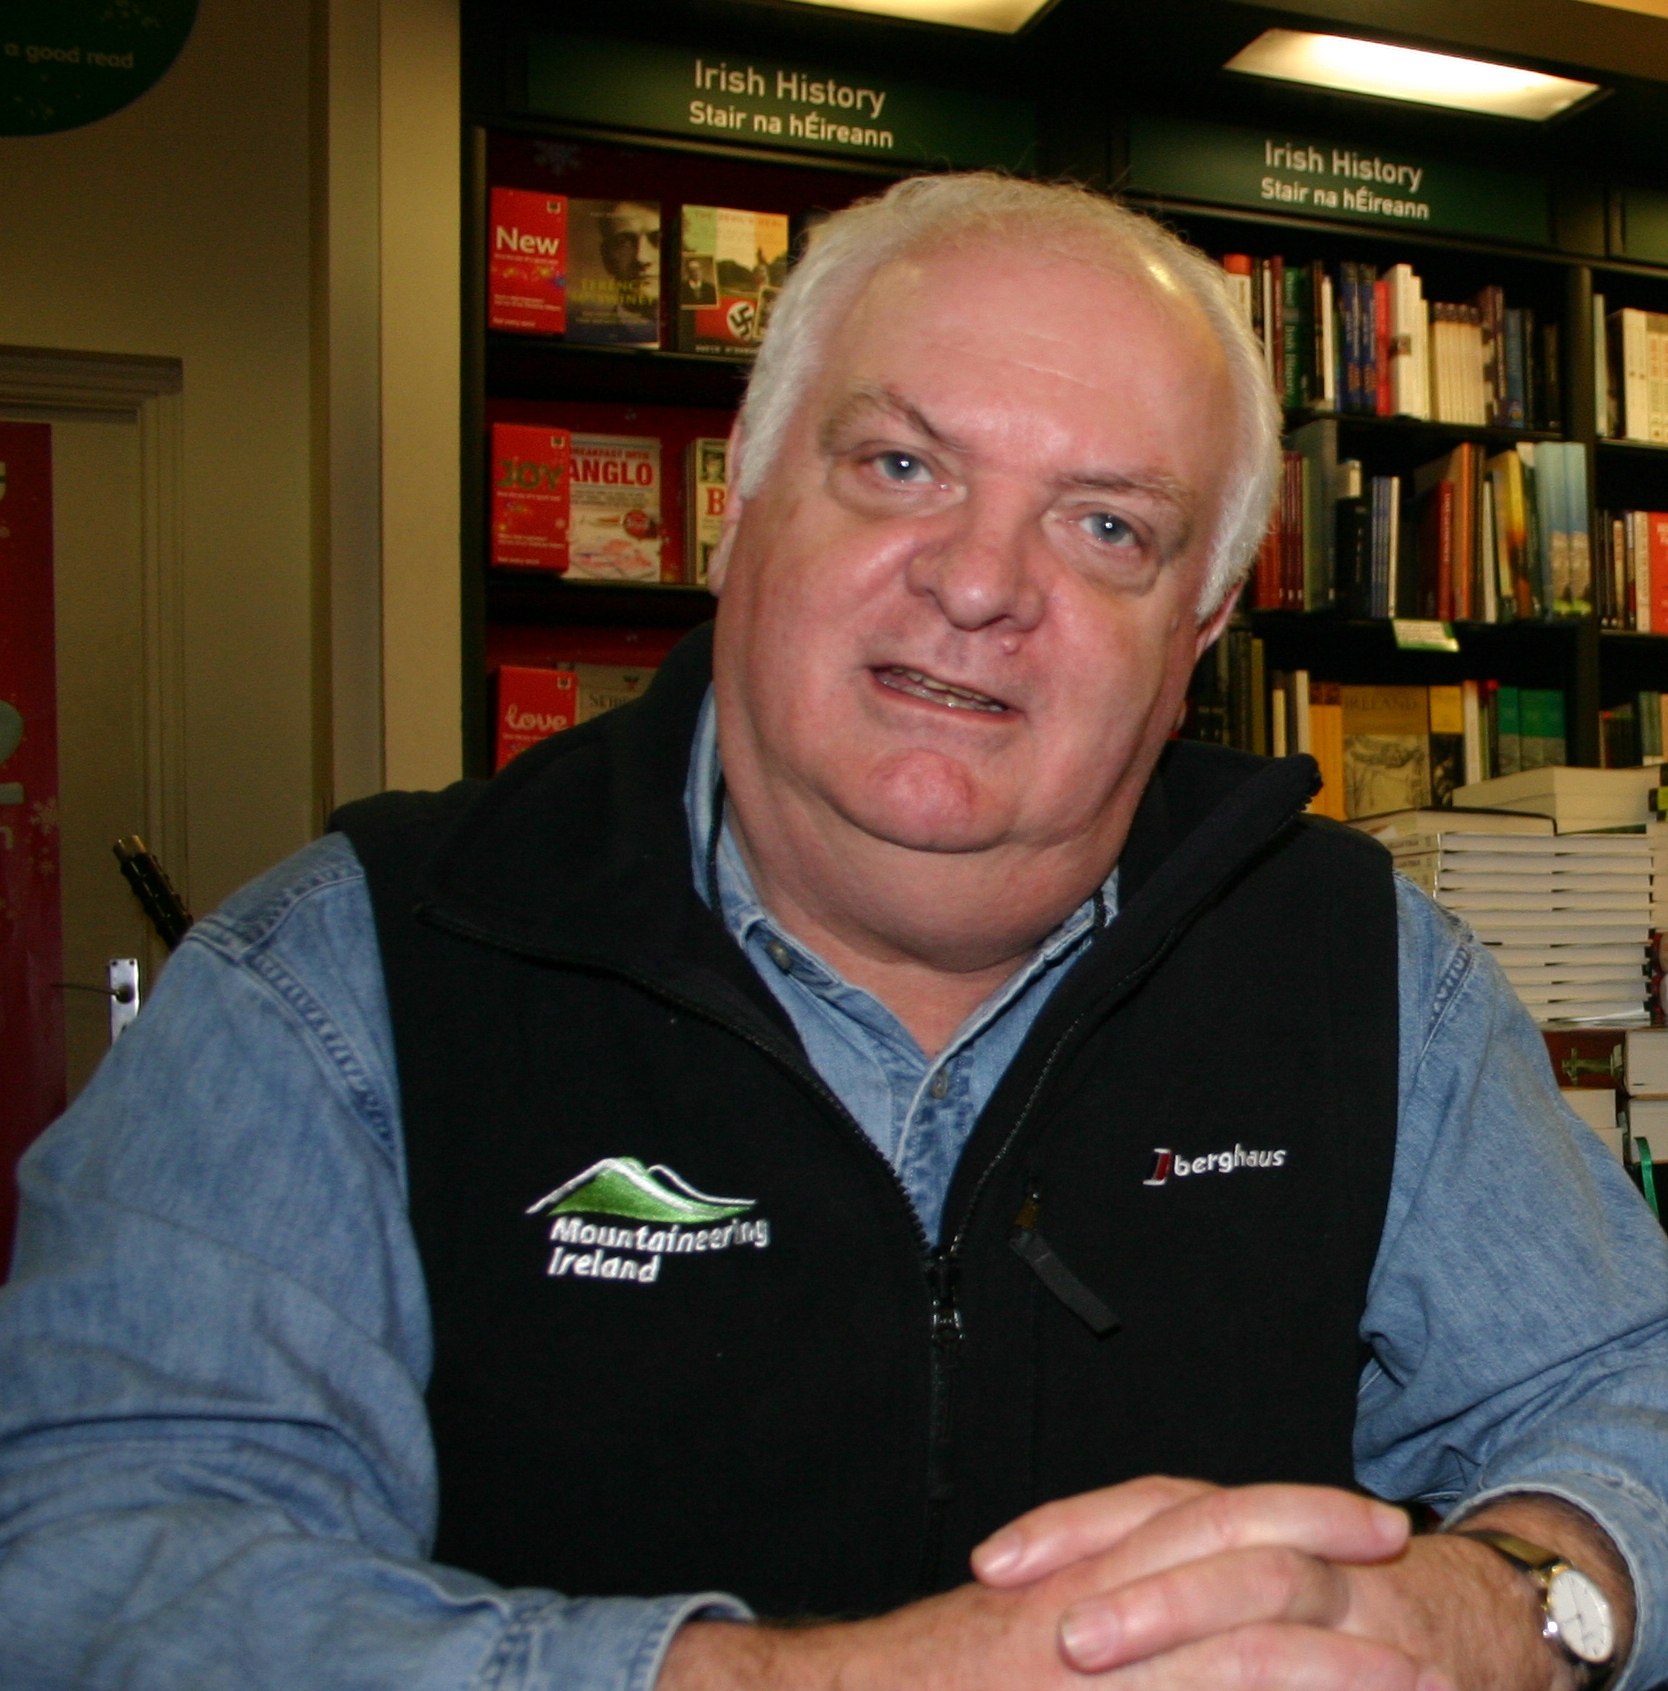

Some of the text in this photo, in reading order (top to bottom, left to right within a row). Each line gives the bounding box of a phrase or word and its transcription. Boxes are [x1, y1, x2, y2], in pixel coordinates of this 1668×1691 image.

[4, 43, 134, 69] a good read
[695, 59, 886, 120] Irish History
[689, 100, 894, 149] Stair na hÉireann
[1265, 139, 1423, 194] Irish History
[1261, 176, 1430, 221] Stair na hÉireann
[496, 225, 560, 256] New
[498, 458, 563, 491] JOY
[569, 459, 653, 487] ANGLO
[504, 703, 567, 732] love
[1173, 1143, 1287, 1177] berghaus
[550, 1216, 771, 1253] Mountaineering
[547, 1246, 661, 1283] Ireland
